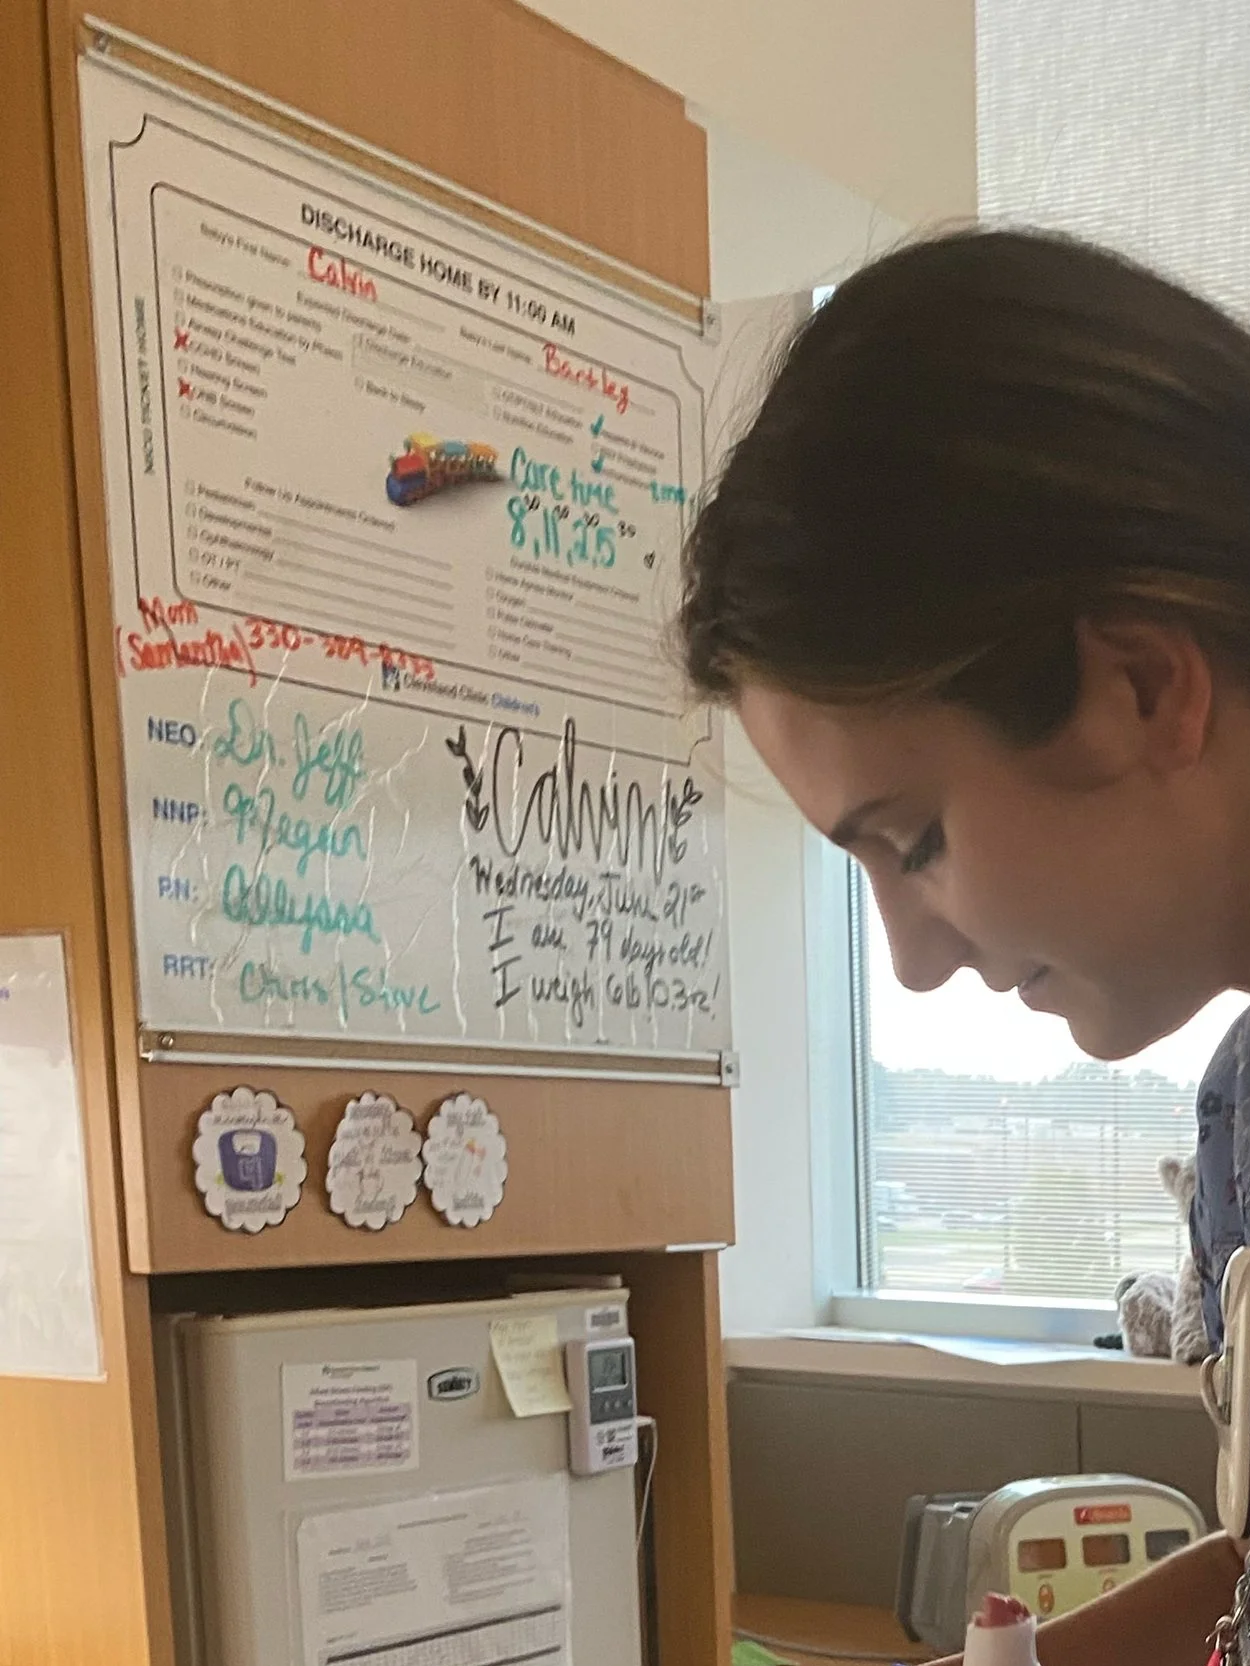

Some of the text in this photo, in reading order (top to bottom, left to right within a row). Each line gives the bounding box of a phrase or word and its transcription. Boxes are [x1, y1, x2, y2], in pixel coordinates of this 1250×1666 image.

[301, 202, 576, 338] DISCHARGE HOME BY 11:00 AM
[308, 245, 378, 303] Calvin
[542, 342, 630, 415] Bartley
[510, 446, 565, 501] Care
[290, 712, 368, 812] Jeff
[483, 904, 515, 952] I
[491, 954, 522, 1010] I
